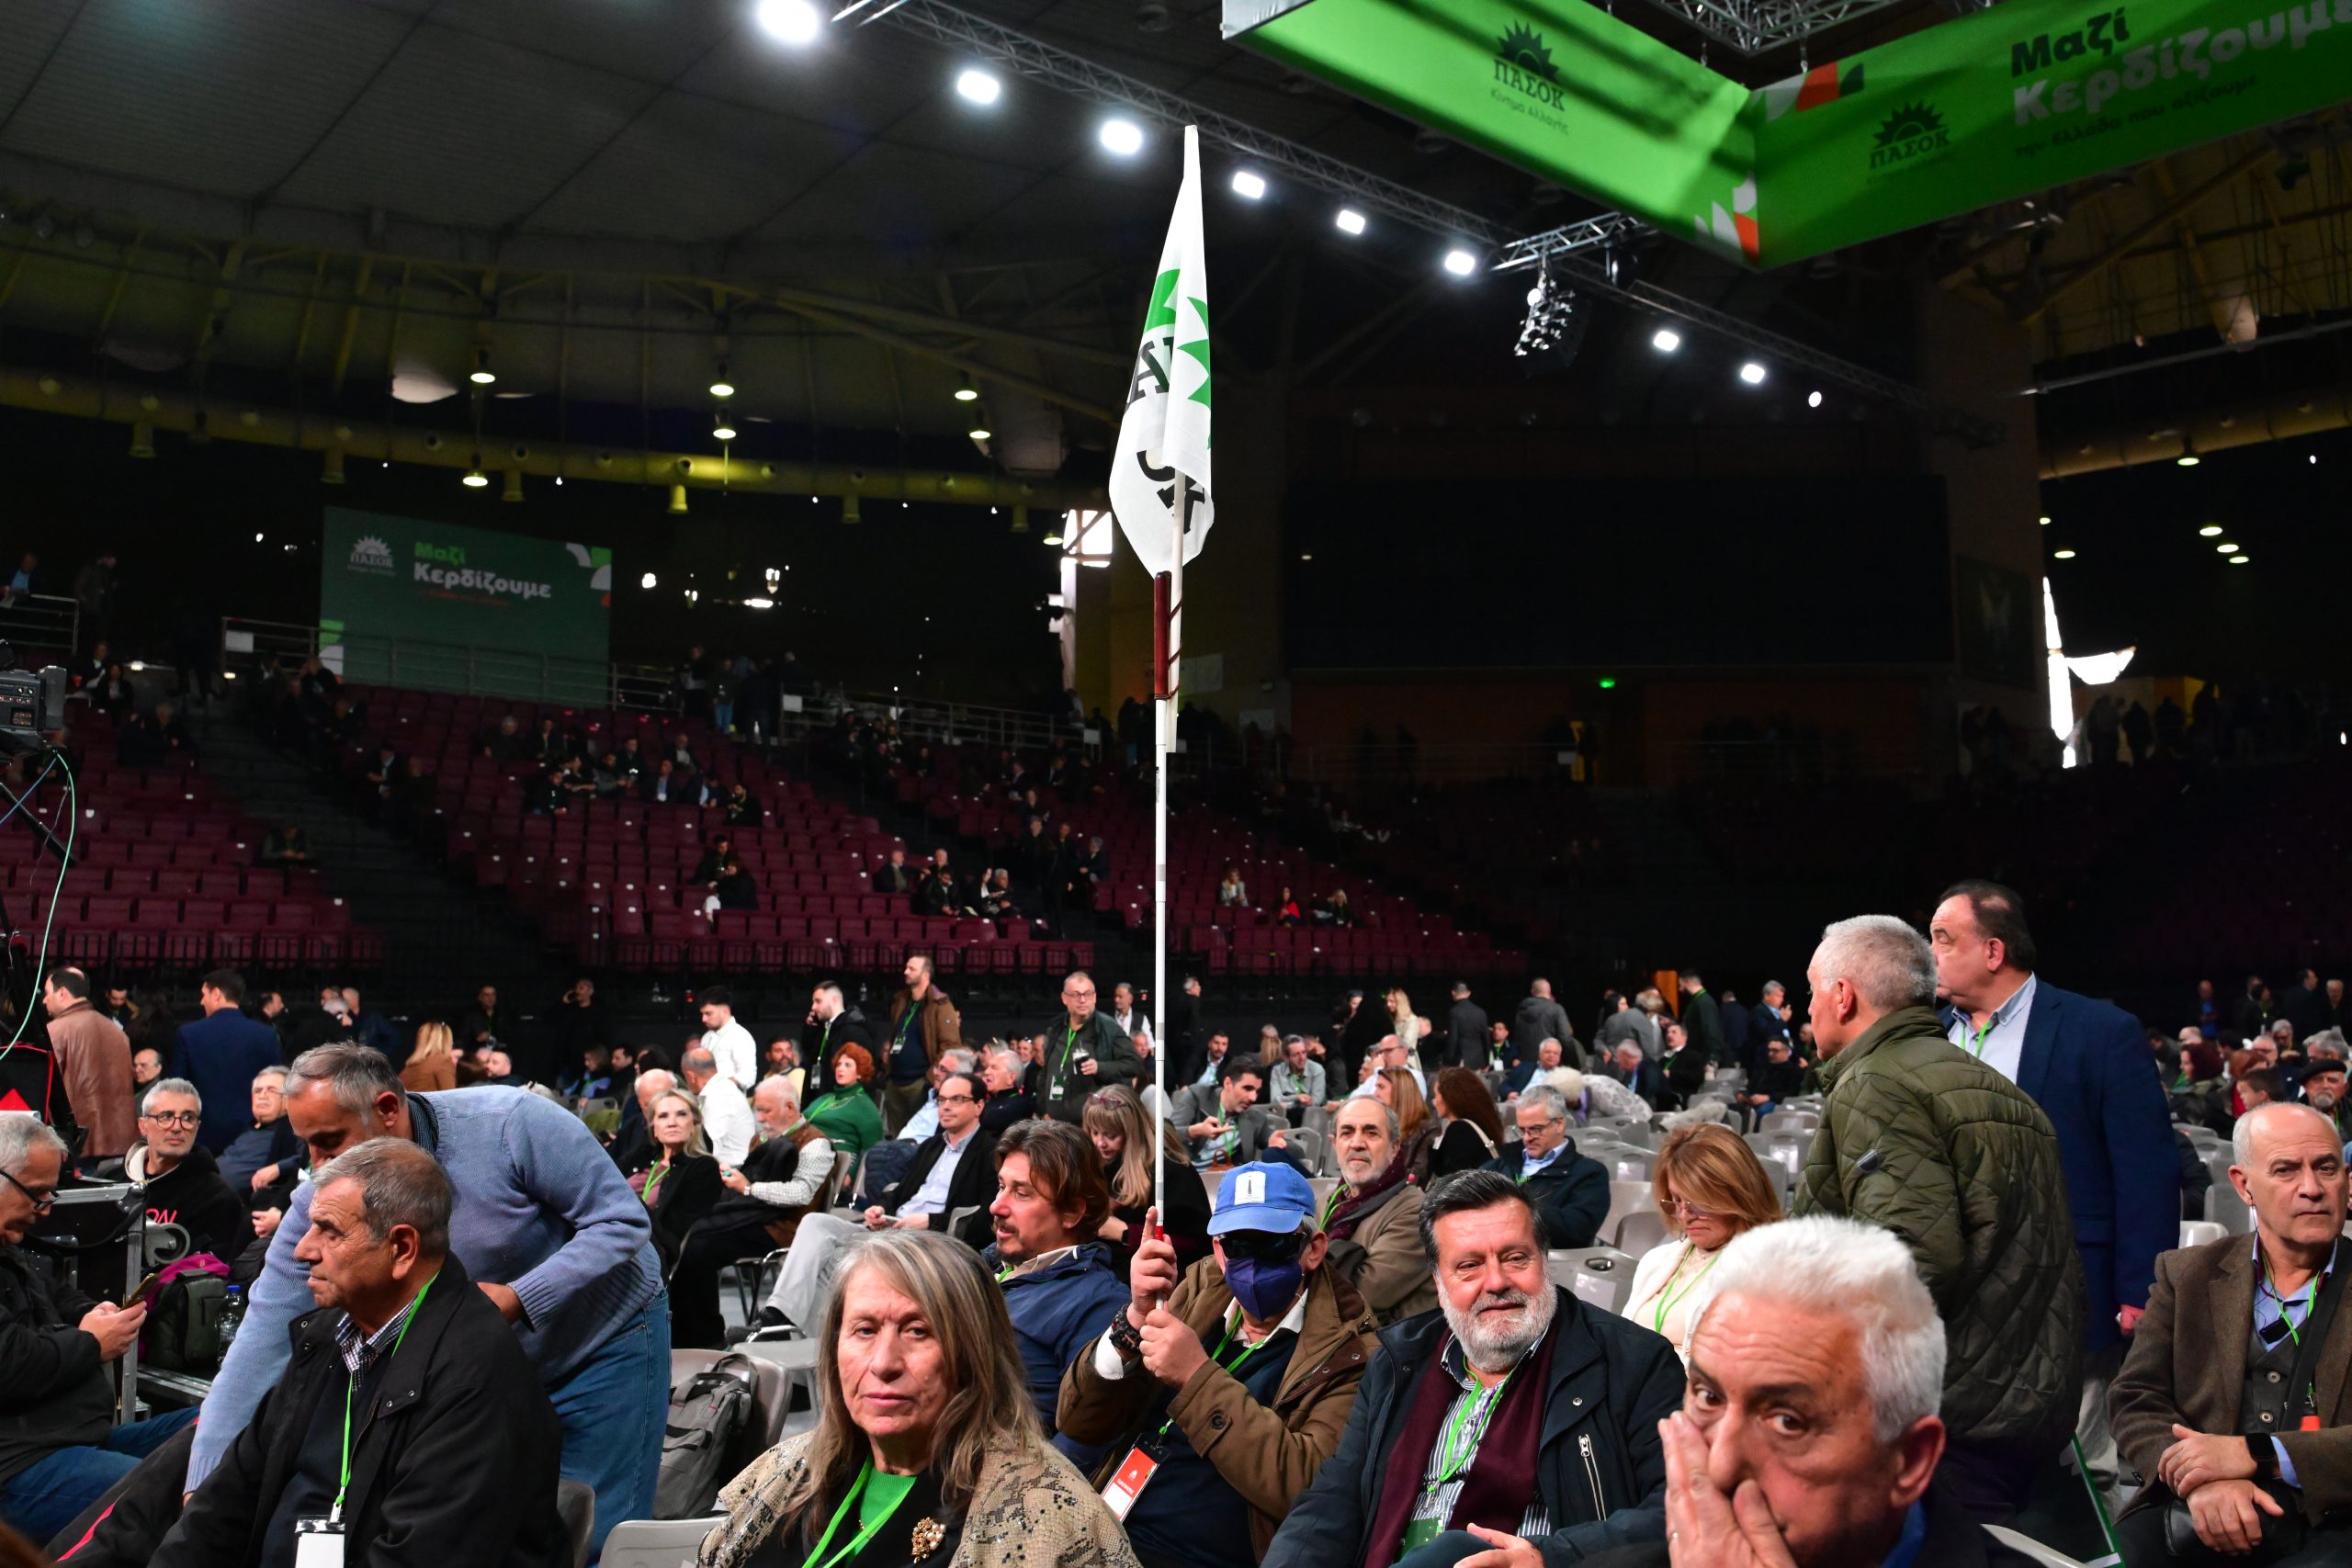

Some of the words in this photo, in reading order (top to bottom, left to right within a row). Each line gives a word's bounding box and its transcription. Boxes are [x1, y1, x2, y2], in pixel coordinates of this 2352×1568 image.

[2011, 6, 2131, 77] Μαζί
[1494, 59, 1566, 112] ΠΑΣΟΚ
[1869, 128, 1952, 169] ΠΑΣΟΚ
[350, 552, 394, 569] ΠΑΣΟΚ
[414, 542, 466, 566] Μαζί
[413, 562, 551, 600] Κερδίζουμε
